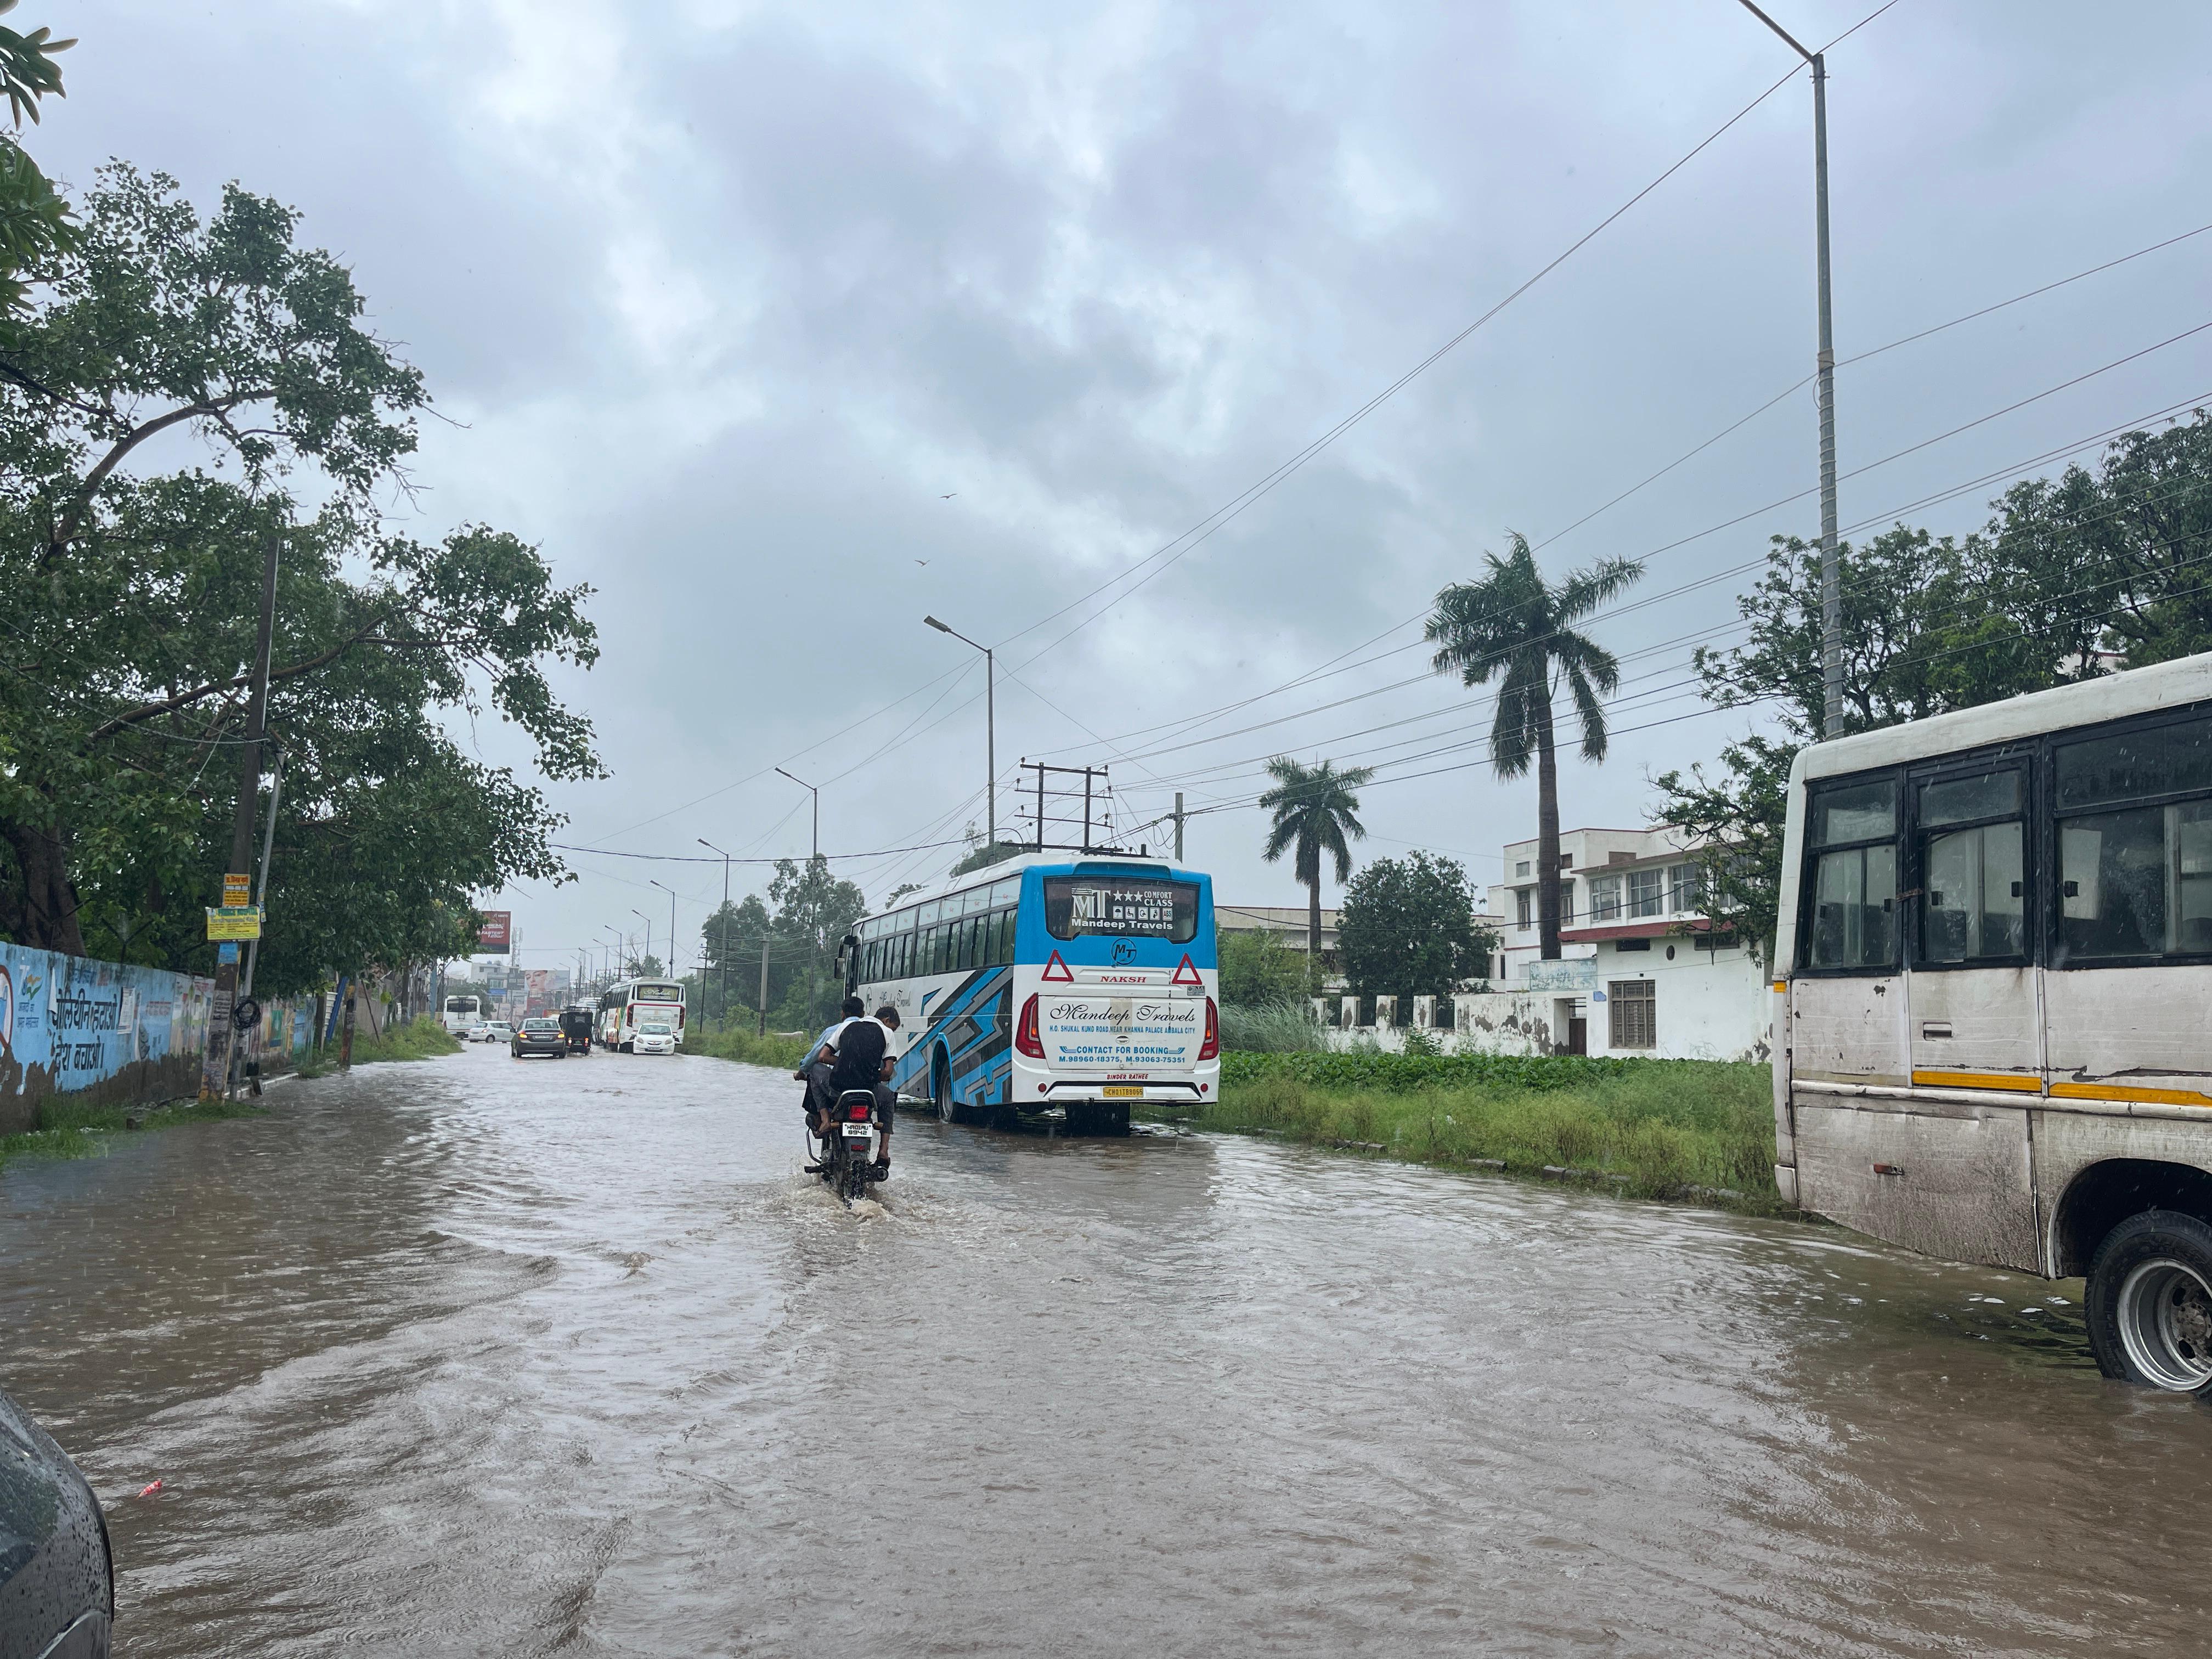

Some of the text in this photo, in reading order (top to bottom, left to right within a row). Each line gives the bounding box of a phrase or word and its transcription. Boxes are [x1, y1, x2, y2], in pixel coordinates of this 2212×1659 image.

[1071, 890, 1111, 918] MT
[1144, 899, 1173, 907] CLASS
[1071, 919, 1173, 930] Mandeep Travels
[1114, 944, 1137, 961] MT
[1050, 1003, 1195, 1025] Mandeep Travels
[1076, 1046, 1113, 1054] CONTACT
